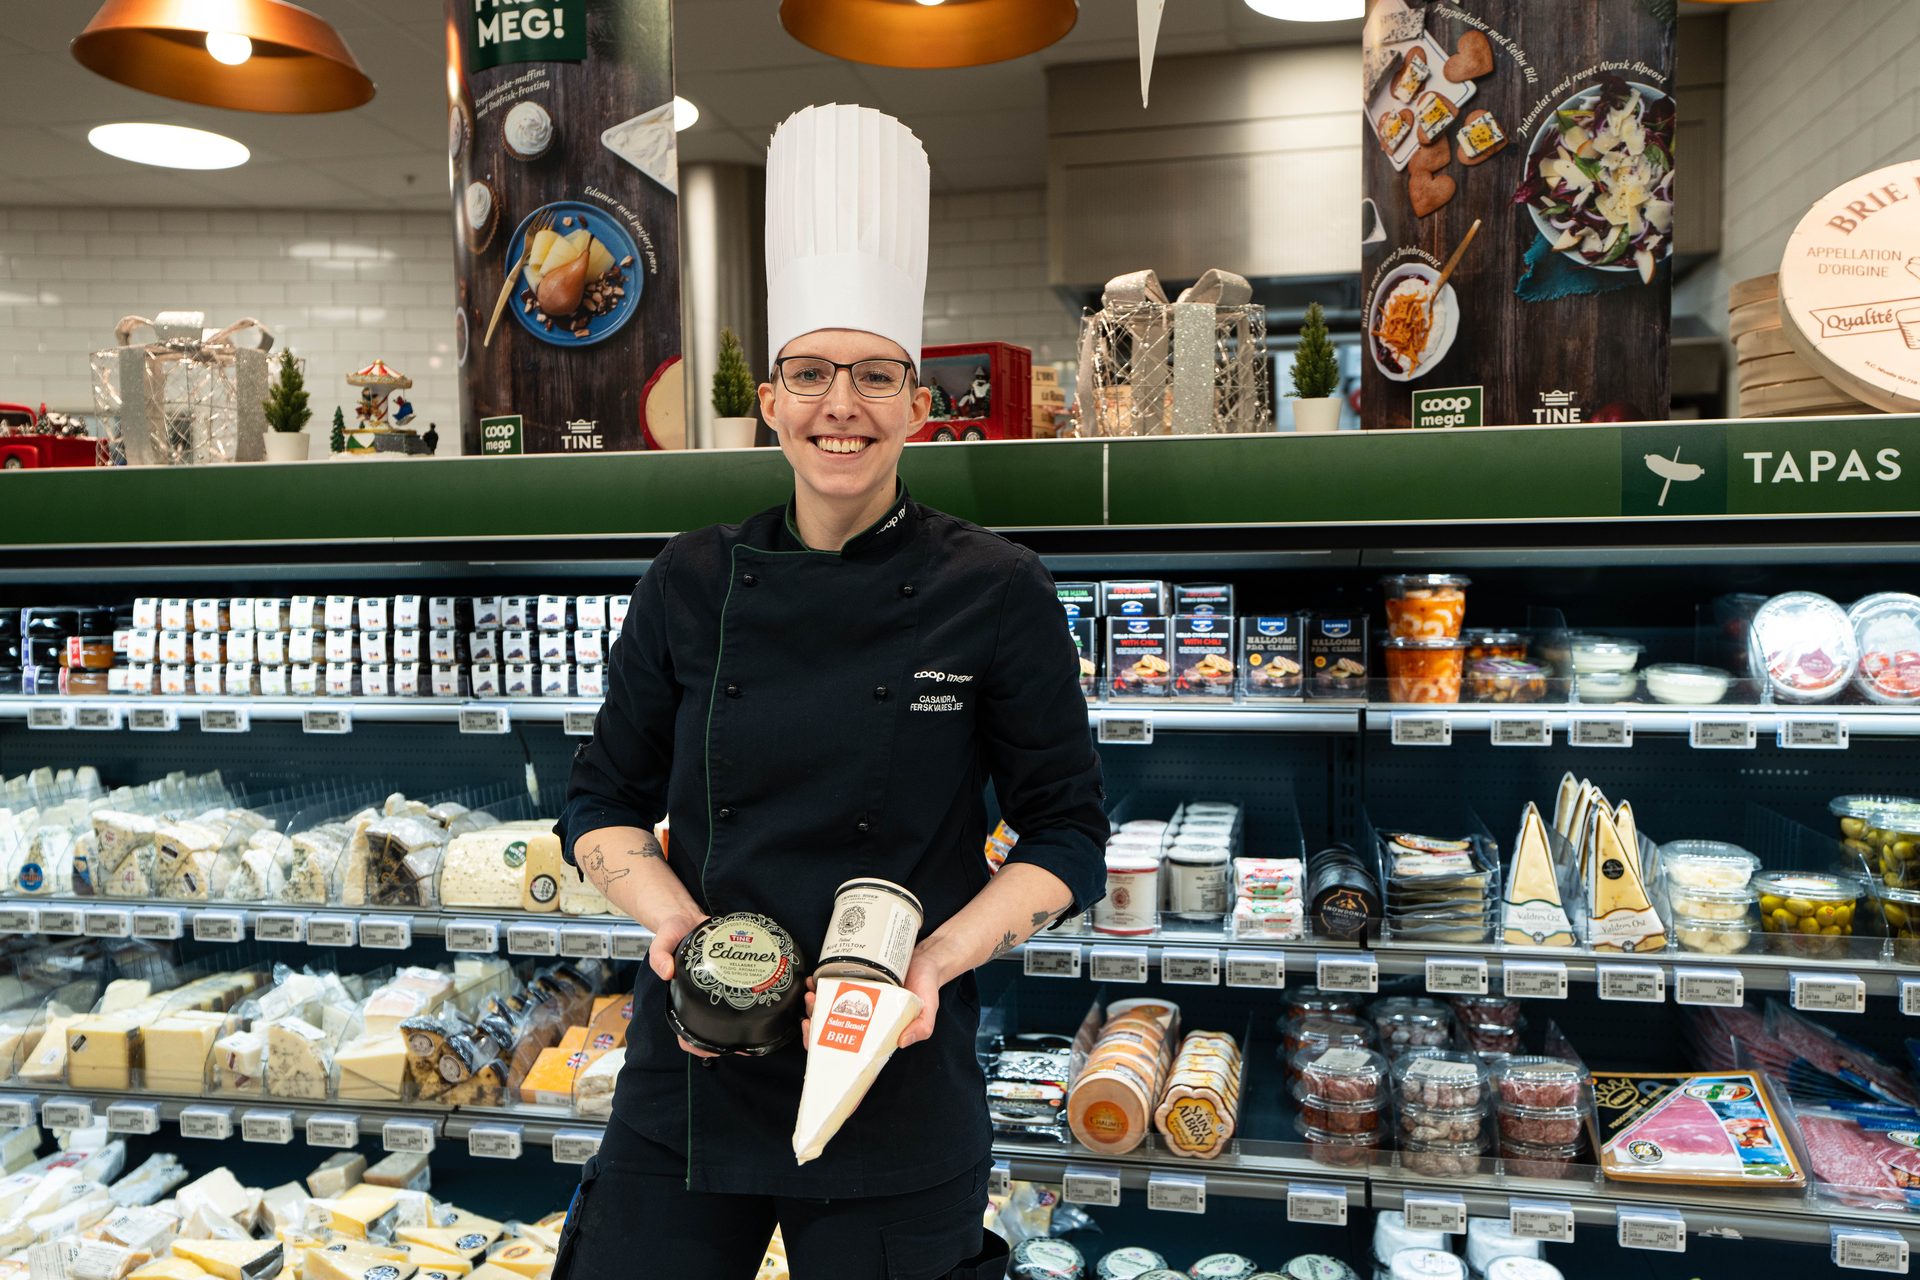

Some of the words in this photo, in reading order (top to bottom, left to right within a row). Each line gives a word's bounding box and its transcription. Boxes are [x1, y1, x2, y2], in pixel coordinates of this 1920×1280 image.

[477, 8, 565, 48] MEG!
[1434, 3, 1489, 31] Pepperkaker
[1488, 29, 1511, 46] med
[1506, 42, 1528, 67] Selbu
[1516, 94, 1551, 139] Julesalat
[1551, 76, 1571, 97] med
[1572, 65, 1598, 83] revet
[1599, 59, 1629, 71] Norsk
[1630, 61, 1668, 84] Alpeost
[584, 186, 617, 205] Edamer
[617, 204, 637, 221] med
[1825, 183, 1909, 236] BRIE
[1397, 244, 1441, 268] Julebrunost
[1807, 247, 1902, 261] APPELLATION
[1818, 263, 1889, 278] D'ORIGINE
[1827, 308, 1894, 331] Qualité
[1420, 396, 1472, 413] coop
[1420, 413, 1465, 428] mega
[1532, 408, 1581, 424] TINE
[485, 424, 515, 439] coop
[485, 439, 511, 453] mega
[561, 435, 603, 449] TINE
[1743, 448, 1902, 485] TAPAS
[1119, 639, 1139, 647] WITH
[1247, 636, 1297, 644] HALLOUMI
[914, 670, 946, 682] coop
[919, 695, 957, 704] CASANDRA
[1323, 904, 1367, 918] SNOWDONIA
[709, 942, 777, 963] Edamer
[828, 1017, 844, 1028] Saint
[827, 1031, 857, 1045] BRIE
[1176, 1105, 1209, 1146] ALBRAY
[1189, 1105, 1213, 1136] SAINT
